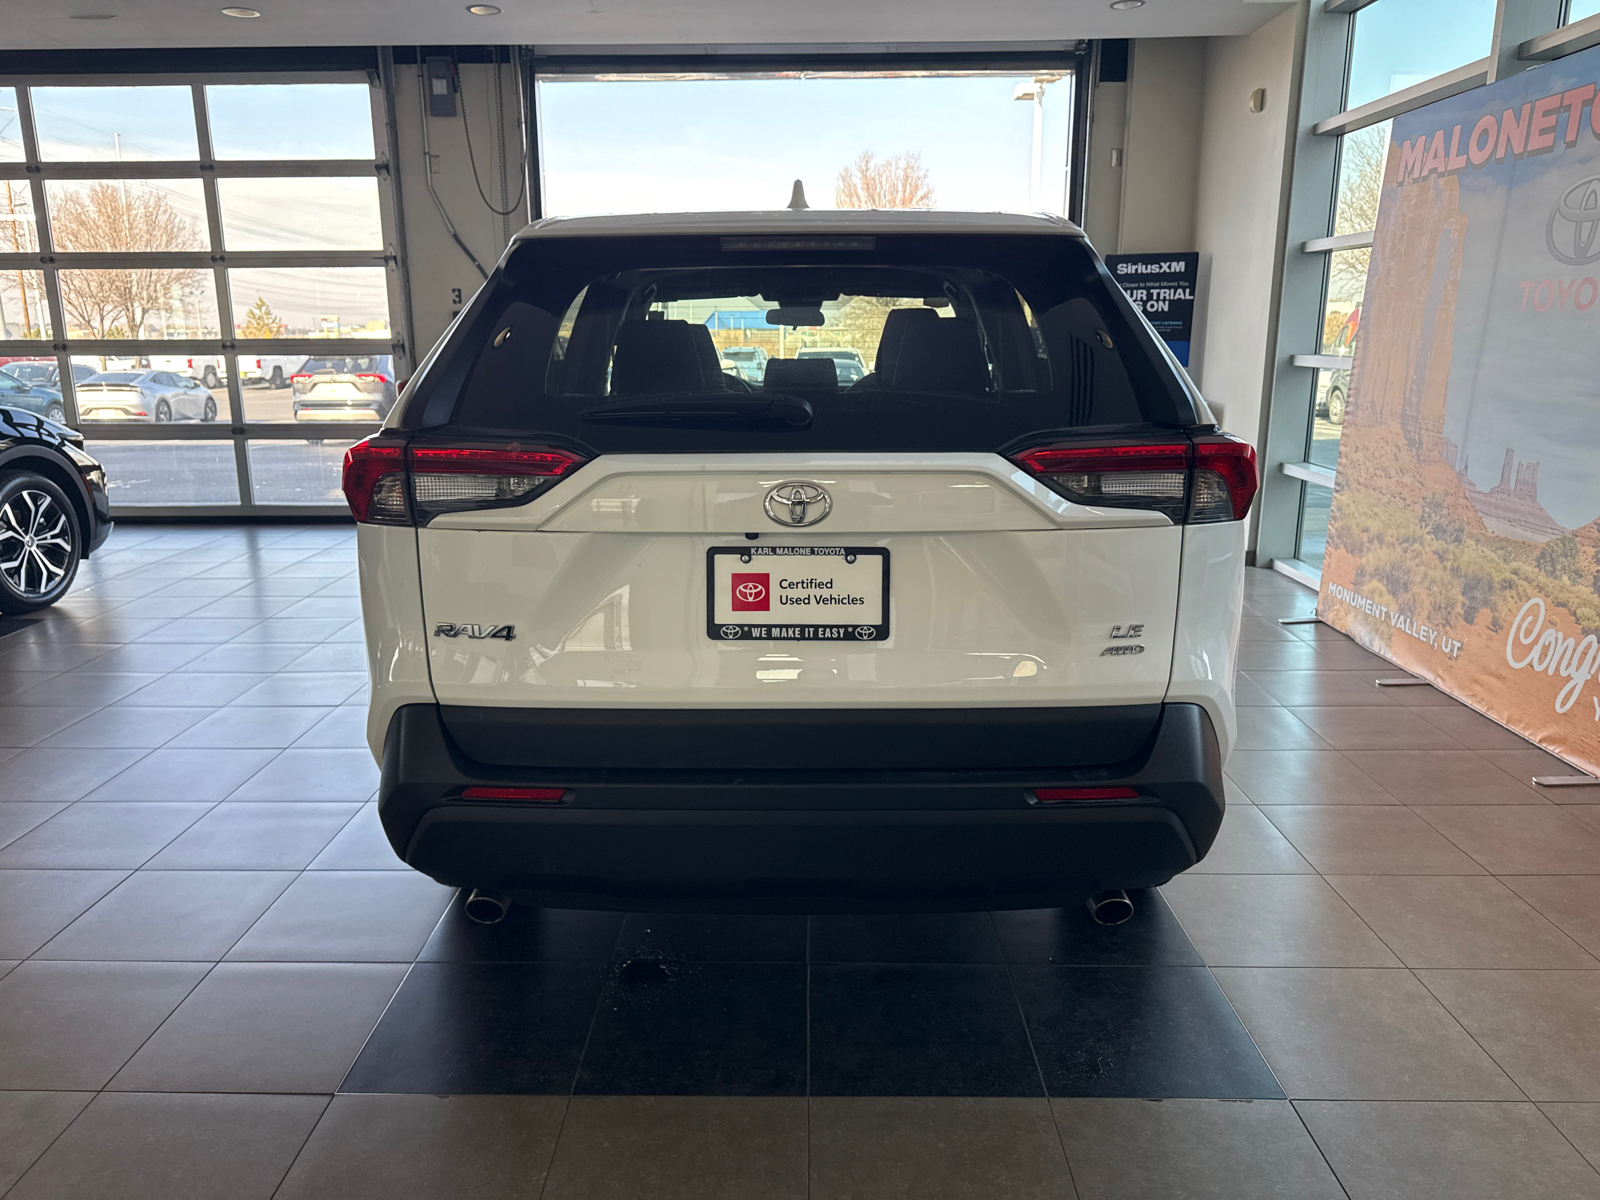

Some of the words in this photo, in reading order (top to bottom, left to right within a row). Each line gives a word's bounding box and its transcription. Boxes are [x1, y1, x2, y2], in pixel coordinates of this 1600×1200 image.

[1117, 261, 1185, 274] SiriusXM
[452, 288, 462, 304] 3
[1150, 288, 1194, 301] TRIAL
[1146, 300, 1169, 312] ON
[751, 548, 774, 556] KARL
[776, 547, 811, 556] MALONE
[813, 547, 846, 556] TOYOTA
[779, 578, 833, 590] Certified
[779, 594, 811, 605] Used
[814, 594, 865, 605] Vehicles
[1327, 581, 1388, 622] MONUMENT
[1389, 610, 1438, 651] VALLEY,
[1442, 638, 1463, 658] UT
[433, 622, 516, 641] RAV4
[751, 627, 767, 638] WE
[771, 627, 801, 638] MAKE
[804, 627, 814, 638] IT
[818, 627, 845, 638] EASY
[1110, 623, 1145, 639] LE
[1099, 643, 1145, 656] AWD
